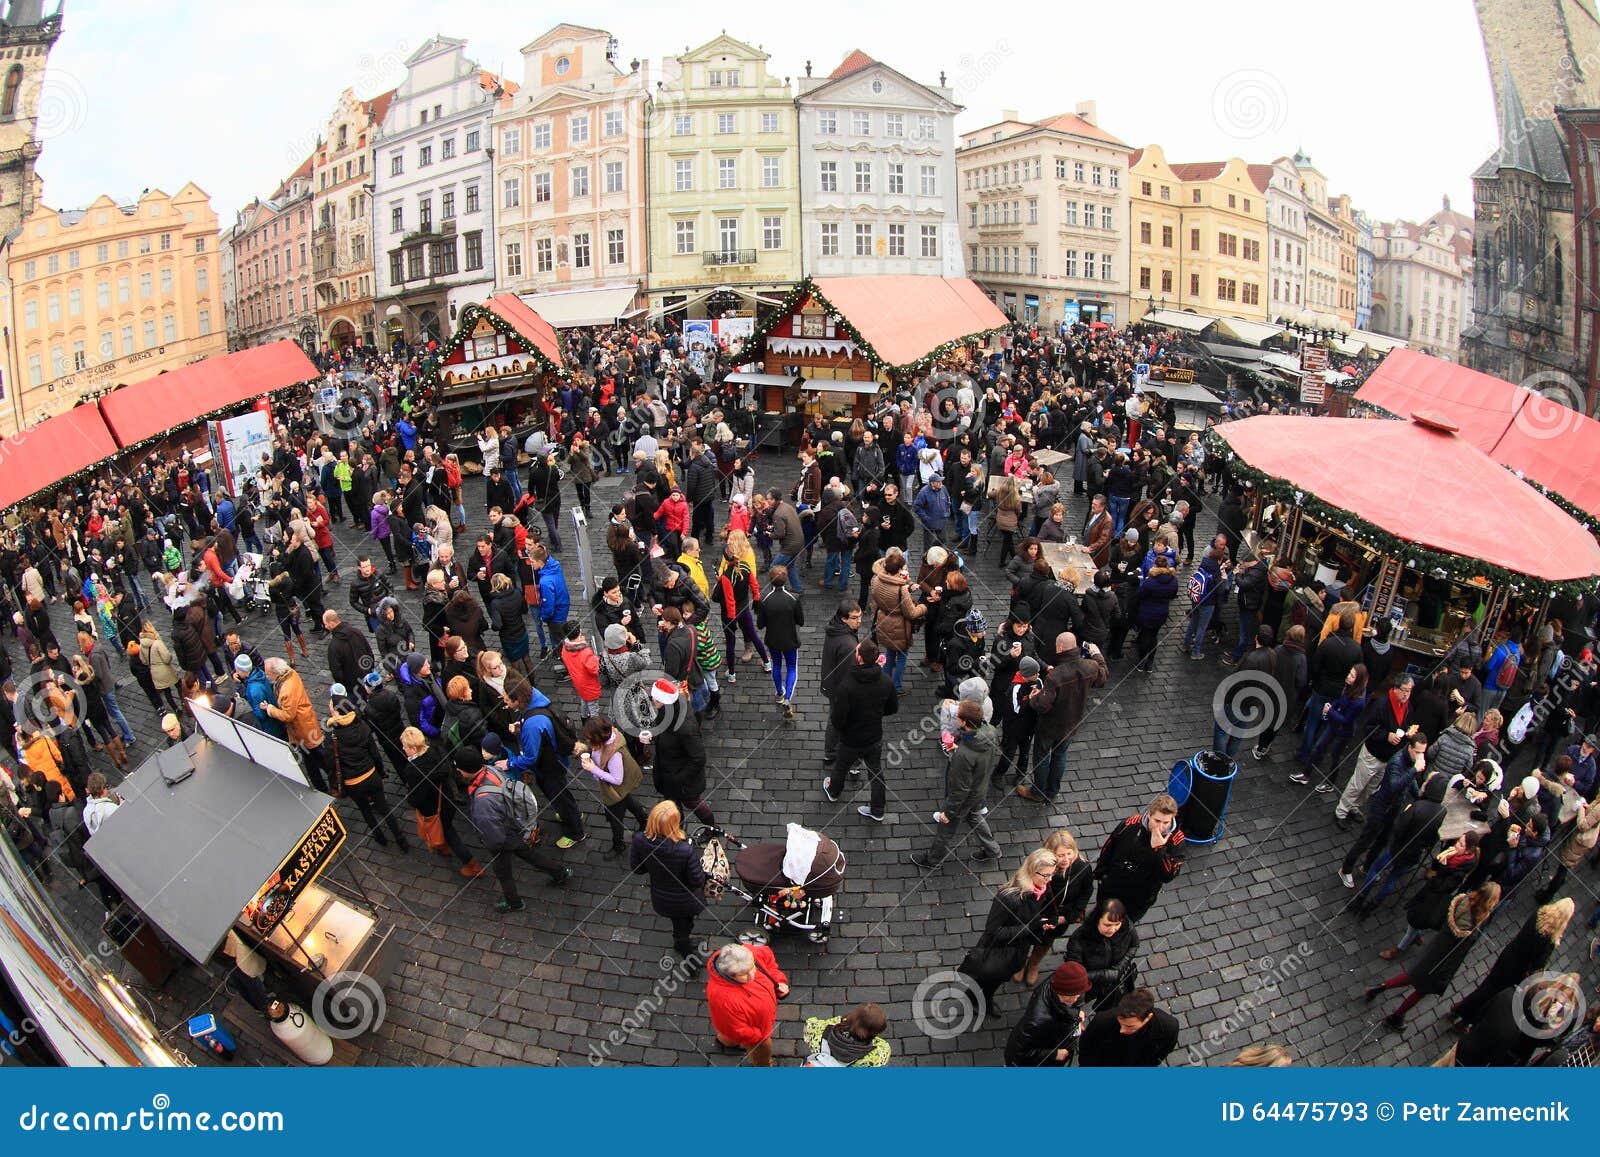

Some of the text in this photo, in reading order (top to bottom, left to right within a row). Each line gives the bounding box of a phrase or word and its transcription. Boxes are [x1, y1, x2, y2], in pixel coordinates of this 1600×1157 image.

[128, 351, 153, 364] WARHOL
[301, 812, 334, 855] PEČENÉ
[283, 822, 337, 891] KAŠTANY
